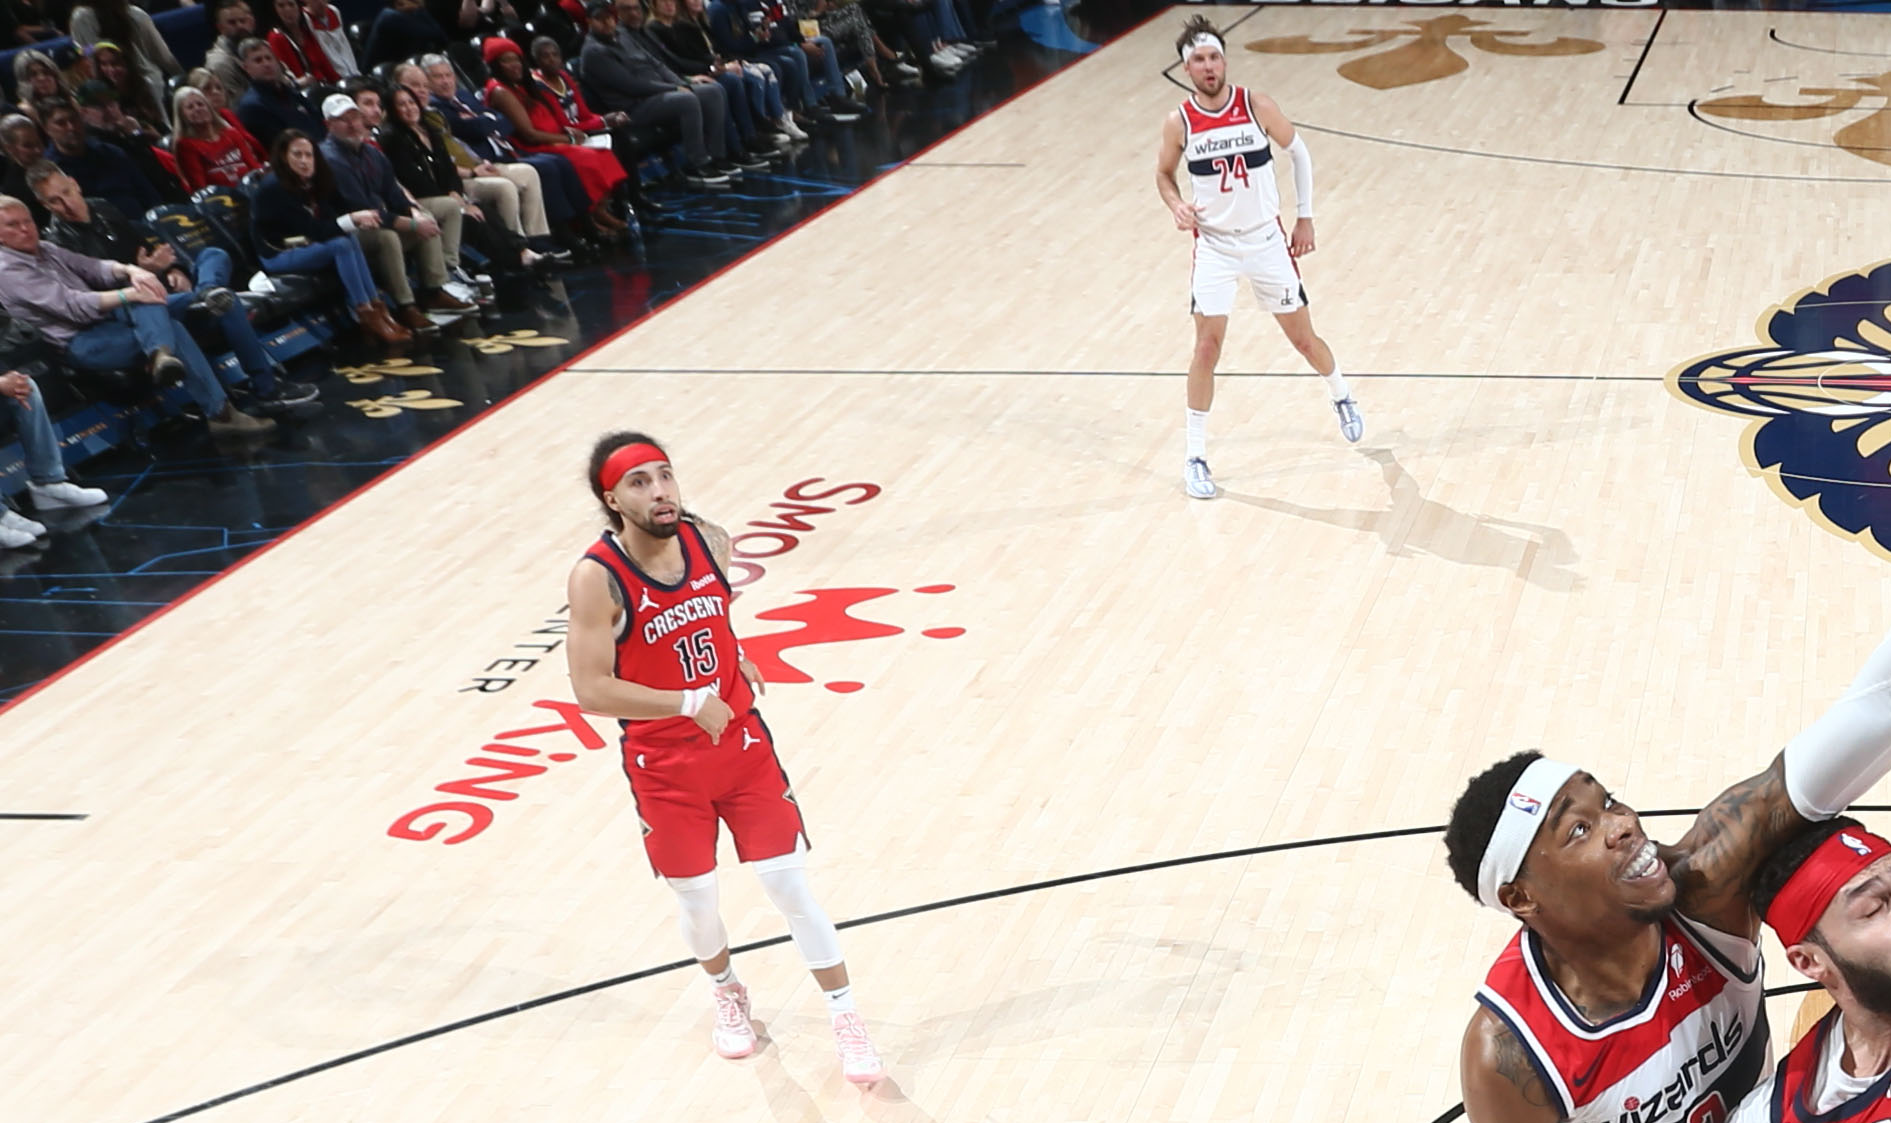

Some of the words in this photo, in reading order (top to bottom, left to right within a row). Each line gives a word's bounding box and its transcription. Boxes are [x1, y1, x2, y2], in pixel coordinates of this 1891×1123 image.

[1194, 129, 1254, 155] wizards
[1212, 154, 1250, 194] 24
[643, 596, 724, 645] CRESCENT
[673, 627, 719, 682] 15
